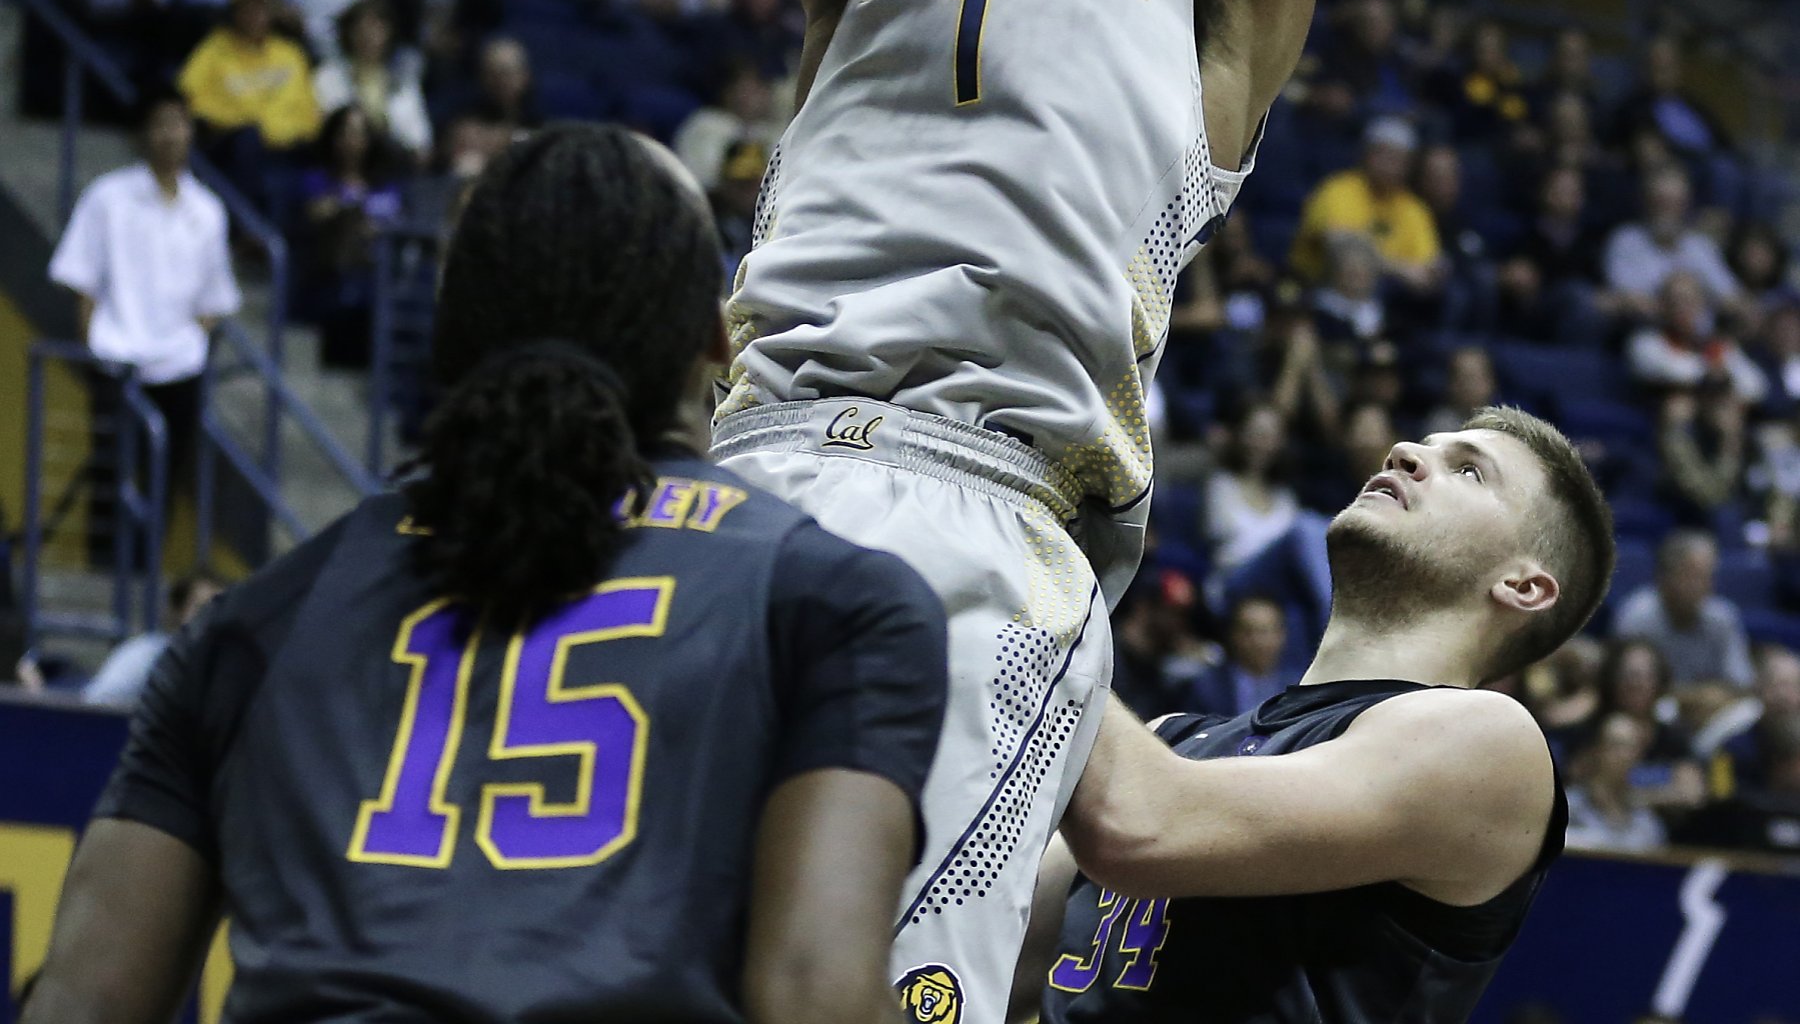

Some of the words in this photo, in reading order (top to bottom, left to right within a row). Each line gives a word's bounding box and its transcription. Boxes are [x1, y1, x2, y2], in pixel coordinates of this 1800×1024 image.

[821, 406, 884, 451] Cal
[347, 576, 676, 870] 15
[1048, 887, 1171, 993] 34
